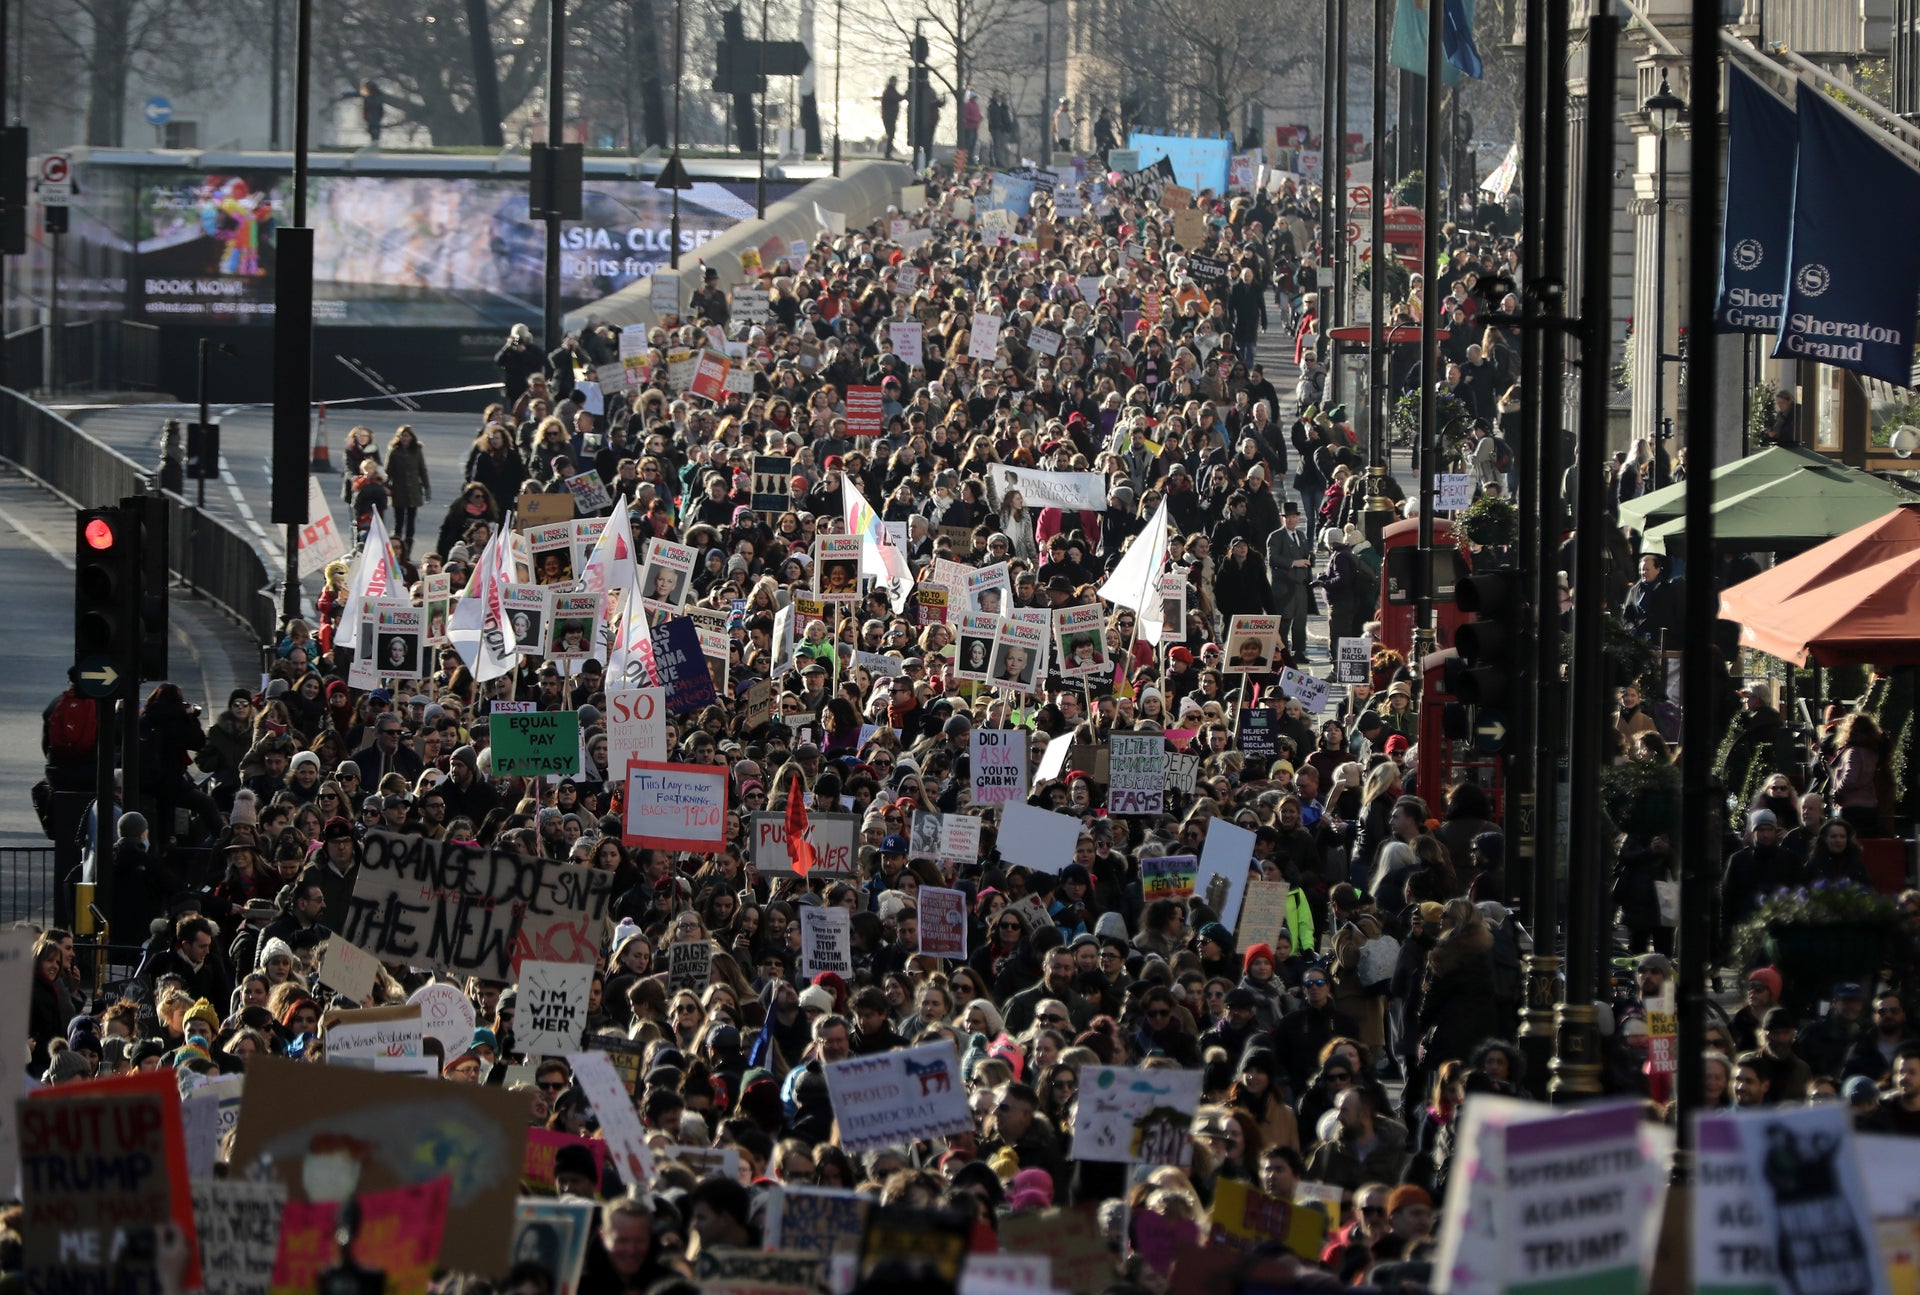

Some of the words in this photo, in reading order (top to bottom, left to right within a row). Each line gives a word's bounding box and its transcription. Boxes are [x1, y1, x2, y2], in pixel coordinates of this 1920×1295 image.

[624, 256, 663, 277] fro
[1190, 258, 1225, 277] Trump
[145, 279, 194, 295] BOOK
[1728, 287, 1783, 309] Sher
[1726, 308, 1782, 329] Gran
[1790, 313, 1901, 345] Sheraton
[1787, 334, 1863, 361] Grand
[1021, 478, 1073, 493] DALSTON
[1024, 487, 1080, 503] DARLINGS
[543, 528, 560, 537] PRIDE
[544, 533, 568, 543] LONDON
[666, 552, 691, 563] LONDON
[668, 546, 686, 556] PRIDE
[980, 569, 996, 578] PRIDE
[980, 572, 1004, 583] LONDON
[920, 596, 945, 605] RACISM
[931, 591, 940, 599] TO
[687, 613, 726, 627] TOGETHER
[975, 616, 992, 625] PRIDE
[1072, 614, 1099, 624] LONDON
[1015, 631, 1040, 641] LONDON
[1016, 625, 1034, 633] PRIDE
[494, 702, 530, 712] RESIST
[612, 693, 656, 724] SO
[510, 716, 558, 734] EQUAL
[614, 725, 635, 736] NOT
[640, 723, 654, 734] MY
[529, 733, 556, 746] PAY
[614, 736, 656, 750] PRESIDENT
[979, 732, 999, 746] DID
[1003, 733, 1007, 745] I
[1111, 737, 1160, 755] FILTER
[980, 747, 1012, 765] ASK
[497, 756, 574, 772] FANTASY
[981, 766, 1003, 776] YOU
[1004, 766, 1019, 776] TO
[694, 784, 712, 792] NOT
[976, 776, 1002, 787] GRAB
[1004, 776, 1018, 786] MY
[977, 787, 1023, 803] PUSSY?
[1110, 790, 1162, 812] FACTS
[641, 804, 667, 816] BACK
[670, 805, 681, 814] TO
[683, 805, 720, 827] 1950
[361, 833, 484, 896] ORANGE
[419, 885, 460, 905] HAVE
[475, 894, 497, 912] TO
[343, 890, 430, 955] THE
[812, 925, 826, 933] There
[673, 943, 709, 961] RAGE
[816, 940, 837, 951] STOP
[813, 950, 842, 961] VICTIM
[672, 962, 708, 975] AGAINST
[809, 959, 848, 971] BLAMING!
[540, 990, 567, 1003] I'M
[529, 1002, 576, 1019] WITH
[532, 1017, 570, 1033] HER
[1651, 1013, 1668, 1024] NO
[1653, 1039, 1670, 1050] NO
[1654, 1050, 1670, 1061] TO
[841, 1083, 900, 1107] PROUD
[848, 1103, 936, 1129] DEMOCRAT
[22, 1104, 105, 1152] SHUT
[23, 1153, 153, 1194] TRUMP
[31, 1200, 78, 1227] AND
[1522, 1188, 1625, 1228] AGAINST
[59, 1229, 102, 1265] ME
[1522, 1230, 1629, 1275] TRUMP
